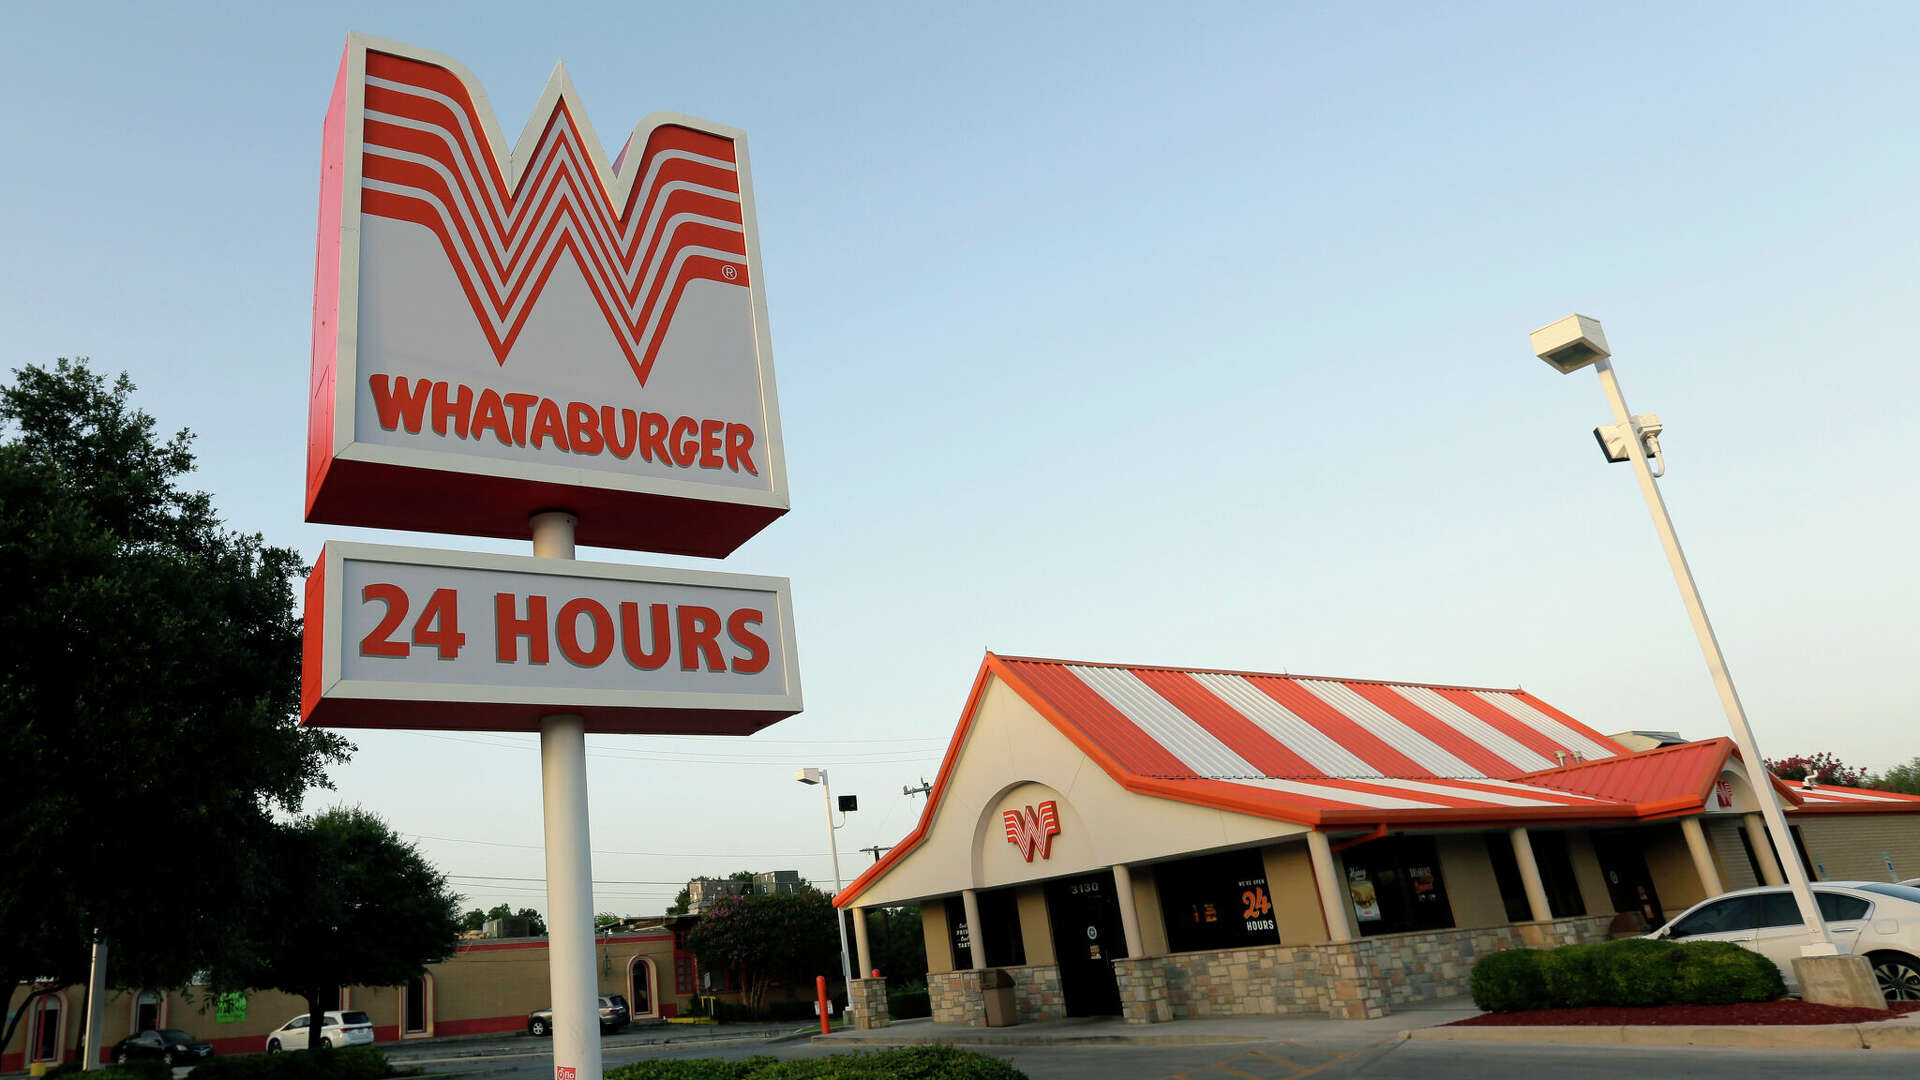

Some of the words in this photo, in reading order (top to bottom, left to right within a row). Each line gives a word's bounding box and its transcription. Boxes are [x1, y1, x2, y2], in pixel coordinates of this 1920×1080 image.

[369, 374, 759, 476] WHATABURGER
[359, 583, 465, 660] 24
[494, 592, 770, 675] HOURS
[1071, 882, 1099, 895] 3130
[1241, 886, 1271, 919] 24
[1246, 920, 1274, 931] HOURS
